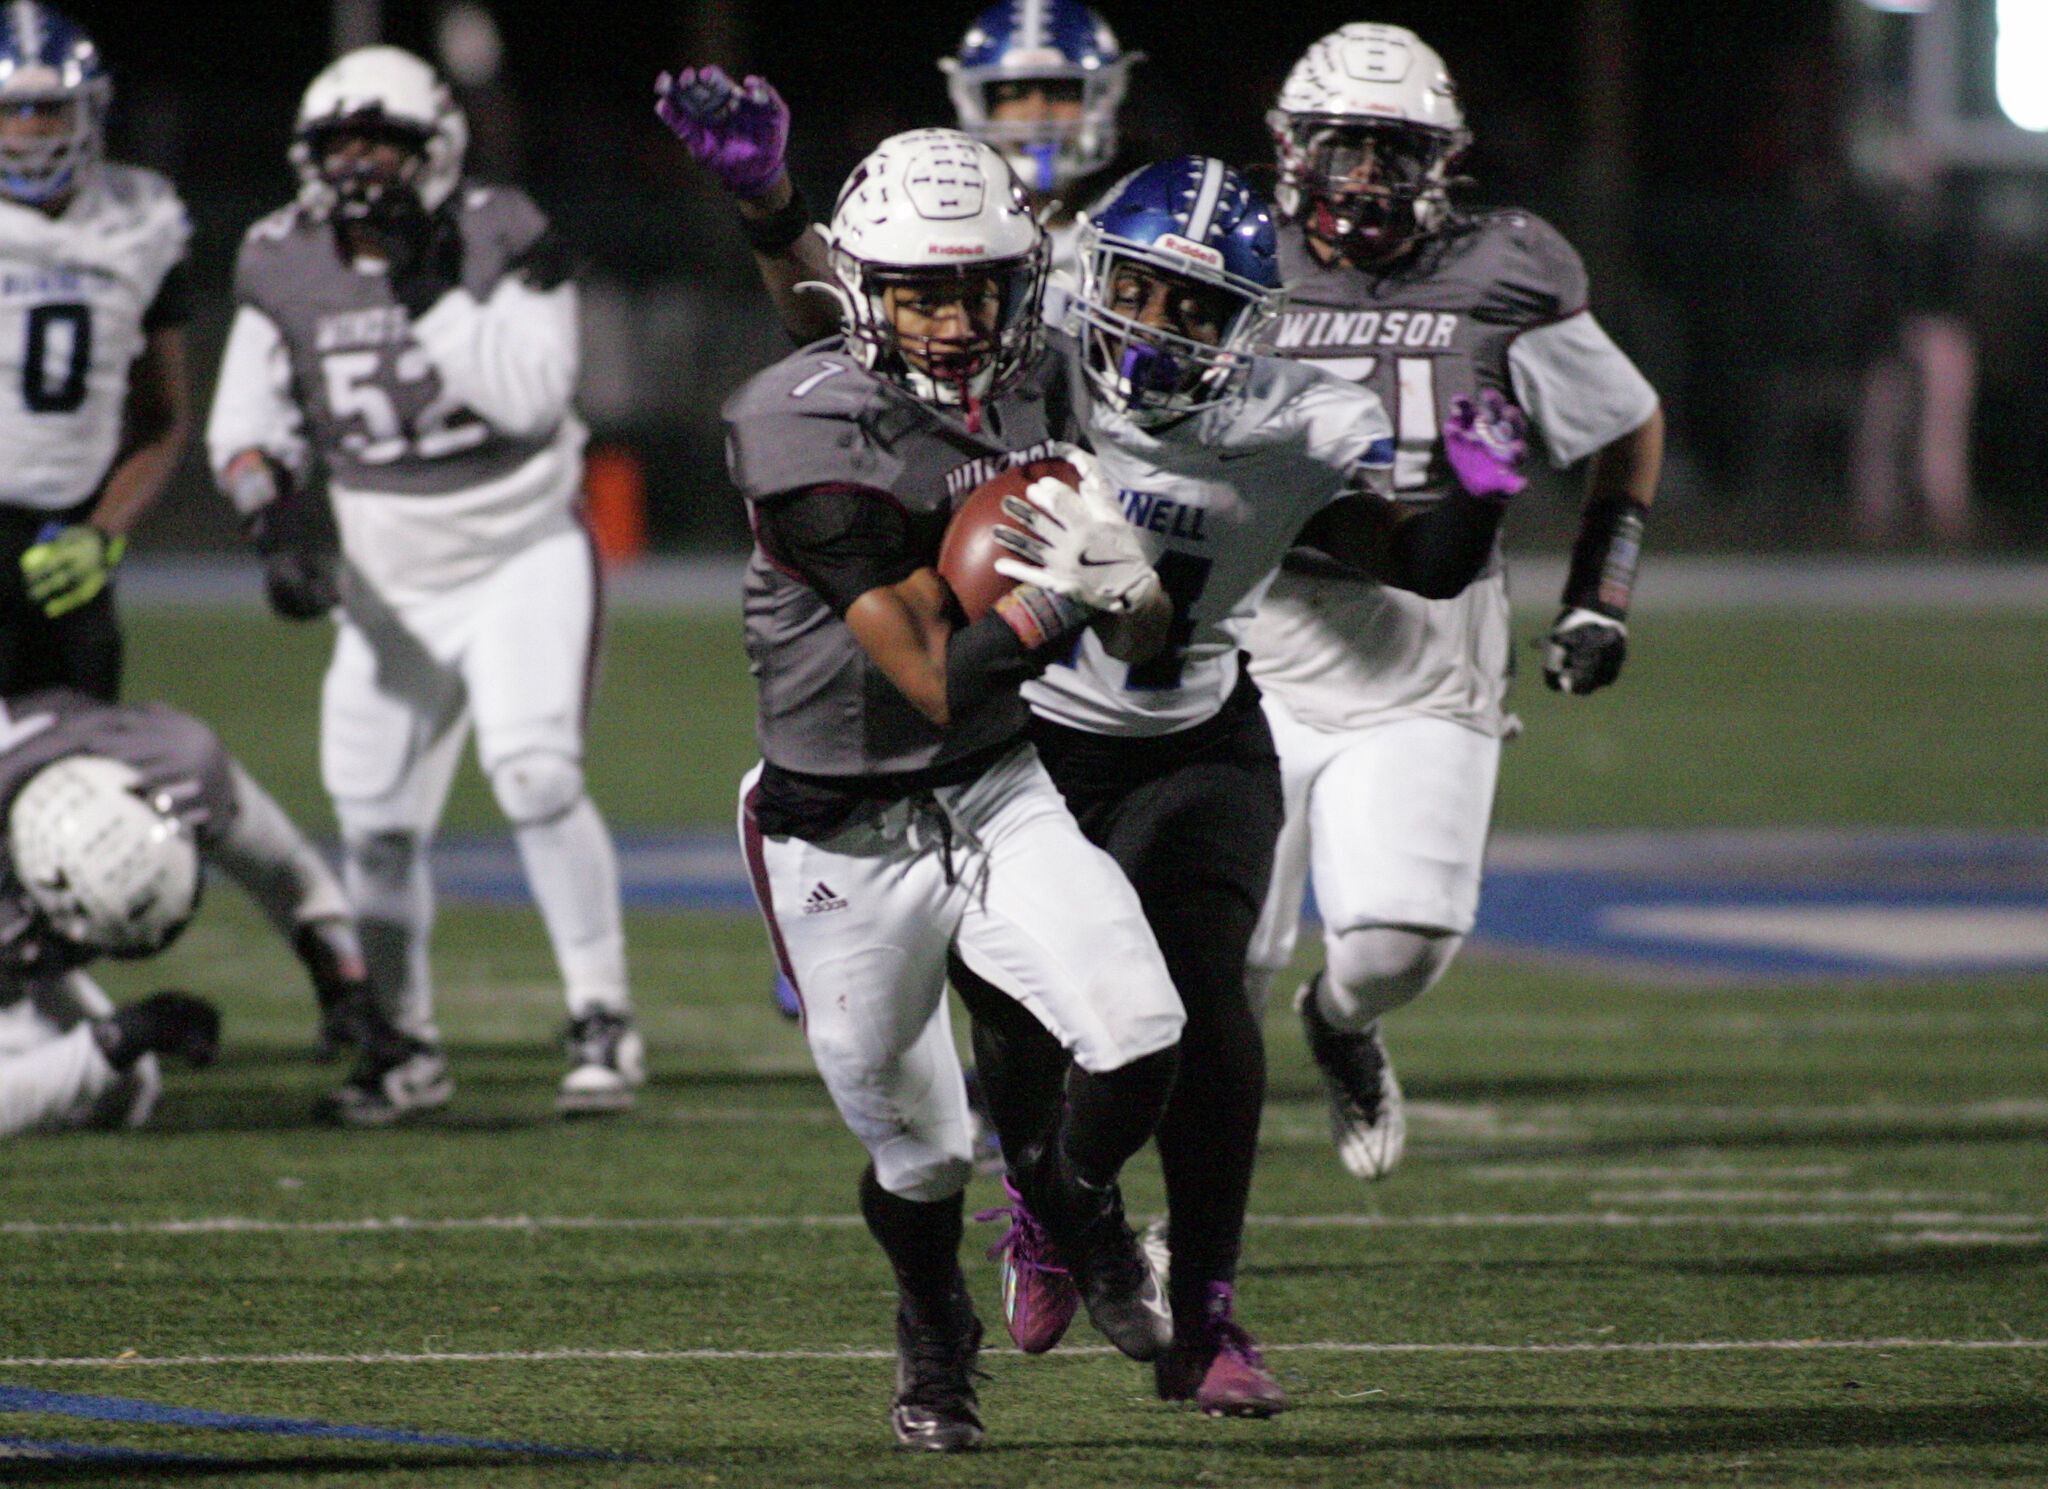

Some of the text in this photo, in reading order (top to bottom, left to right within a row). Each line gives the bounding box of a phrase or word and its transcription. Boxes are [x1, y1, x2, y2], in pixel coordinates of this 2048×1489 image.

[22, 304, 92, 413] 0
[1275, 311, 1458, 348] WINDSOR
[324, 351, 489, 464] 52
[790, 360, 847, 397] 7
[1297, 358, 1438, 488] 1
[1118, 489, 1207, 540] NELL
